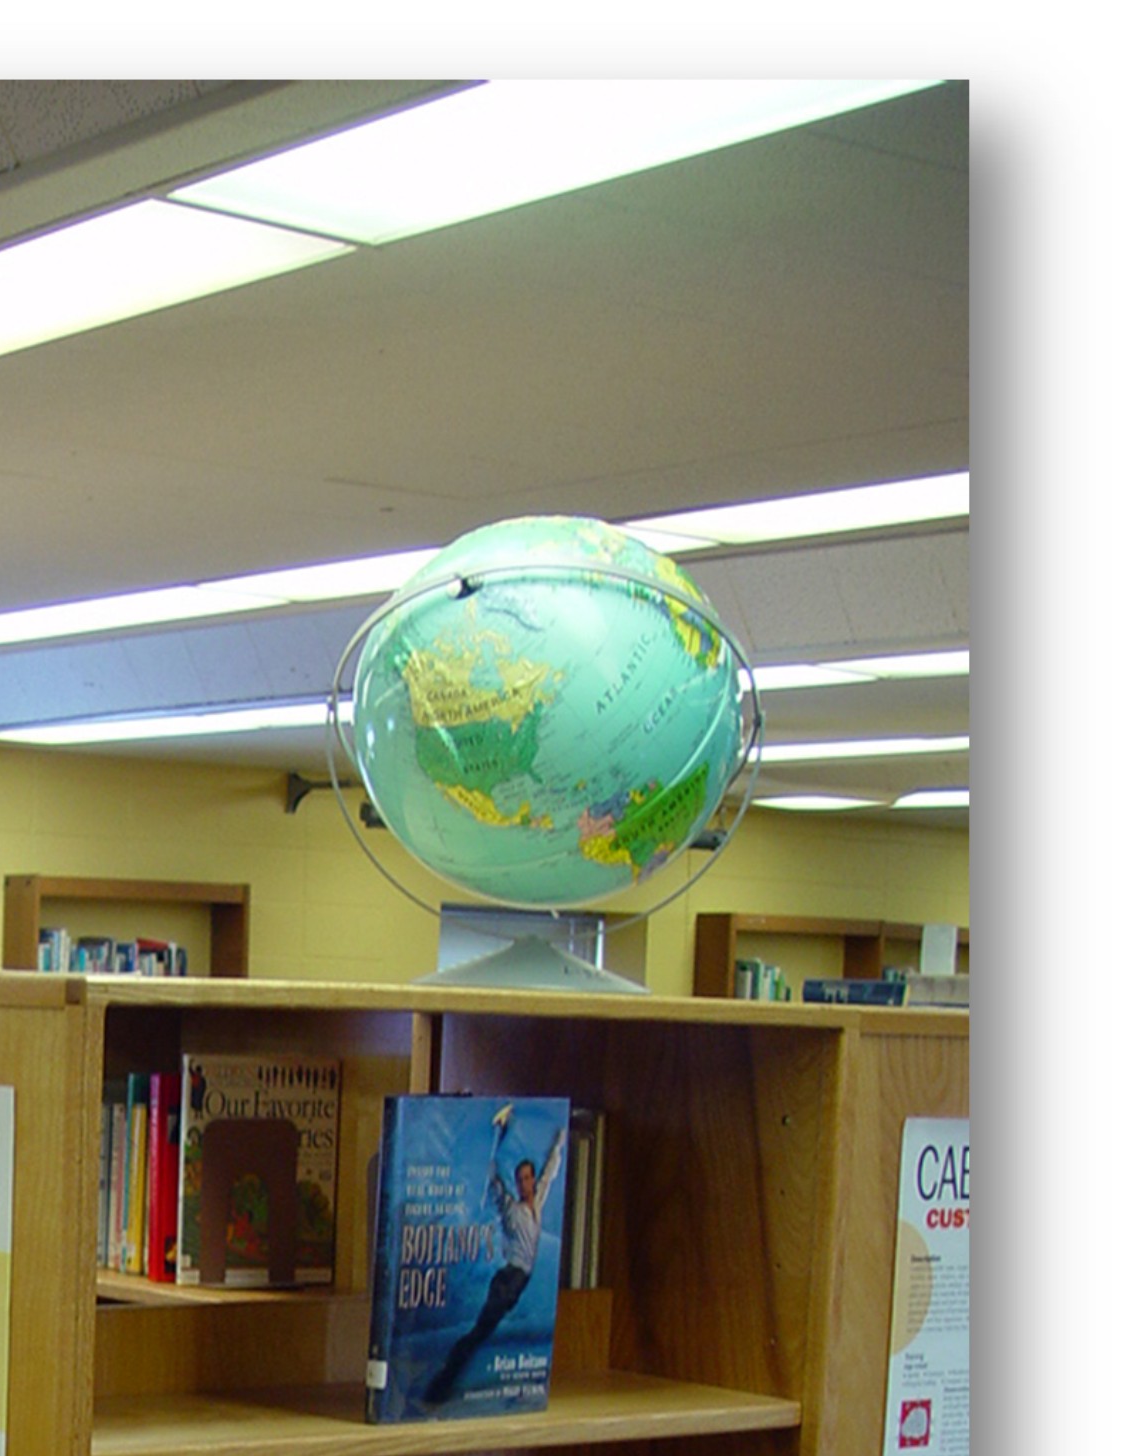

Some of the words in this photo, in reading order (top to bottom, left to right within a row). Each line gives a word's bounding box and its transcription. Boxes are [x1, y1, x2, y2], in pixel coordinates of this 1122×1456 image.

[595, 633, 651, 715] ATLANTIC
[401, 1224, 495, 1266] BOITANO'S
[398, 1267, 447, 1310] EDGE
